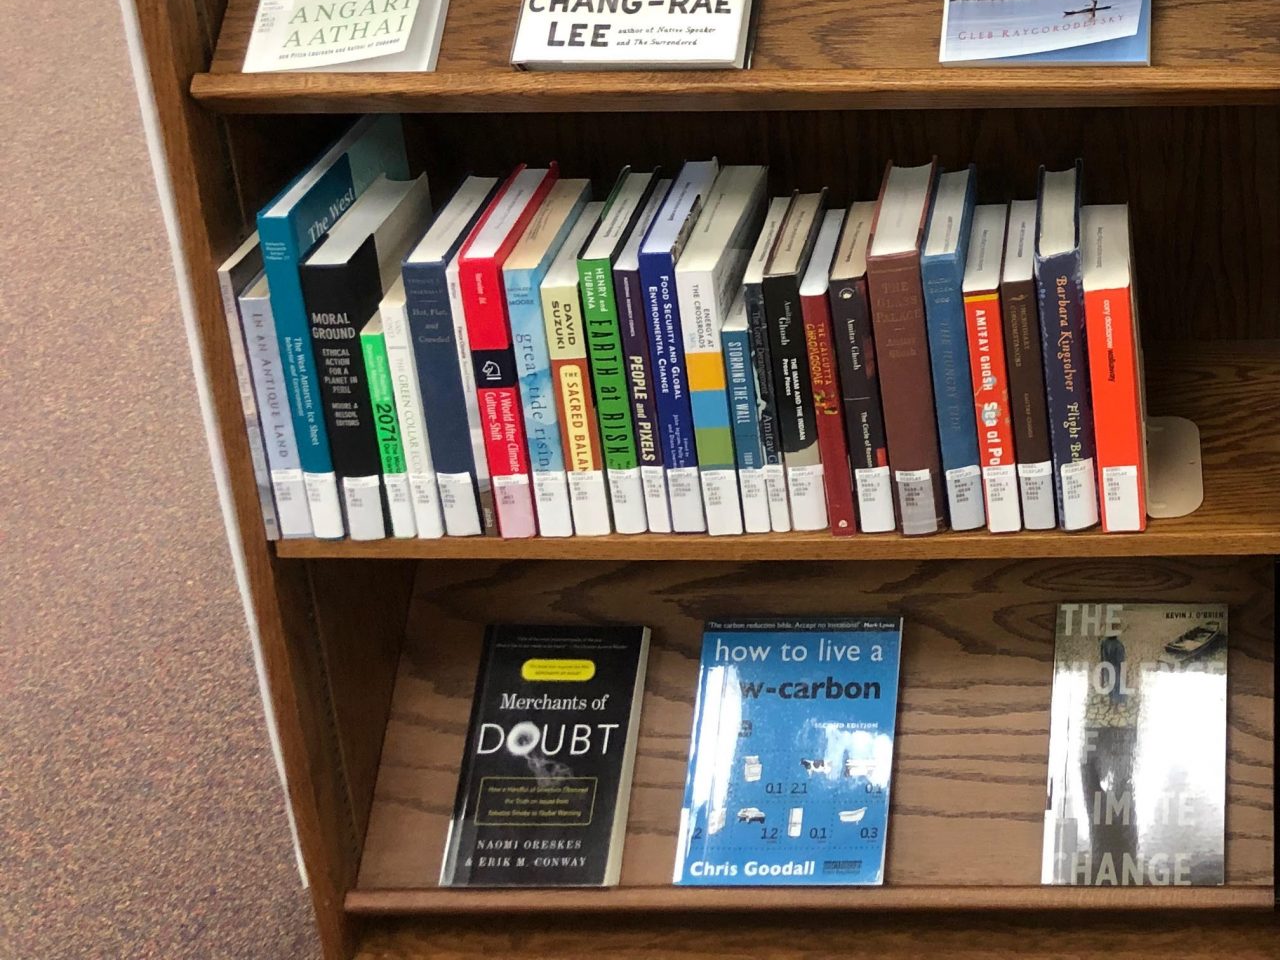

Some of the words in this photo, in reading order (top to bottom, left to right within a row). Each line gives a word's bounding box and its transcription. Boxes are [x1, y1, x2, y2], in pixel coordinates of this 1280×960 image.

[282, 15, 408, 48] AATHAI
[547, 21, 611, 48] LEE
[1056, 276, 1069, 326] Barbara
[311, 313, 350, 324] MORAL
[312, 328, 356, 340] GROUND
[551, 301, 565, 349] SUZUKI
[564, 304, 576, 346] DAVID
[590, 320, 617, 376] EARTH
[728, 342, 745, 384] STORMING
[1055, 330, 1075, 392] Kingsolver
[601, 386, 619, 401] at
[630, 356, 647, 399] PEOPLE
[735, 386, 747, 400] THE
[376, 403, 397, 443] 2071
[636, 404, 647, 419] and
[736, 404, 750, 424] WALL
[603, 413, 631, 455] RISK
[639, 422, 656, 461] PIXELS
[1060, 604, 1123, 636] THE
[715, 638, 771, 662] how
[781, 642, 807, 662] to
[818, 638, 861, 662] live
[870, 644, 883, 662] a
[499, 693, 587, 710] Merchants
[591, 694, 610, 711] of
[476, 721, 619, 756] DOUBT
[690, 860, 738, 876] Chris
[744, 860, 816, 876] Goodall
